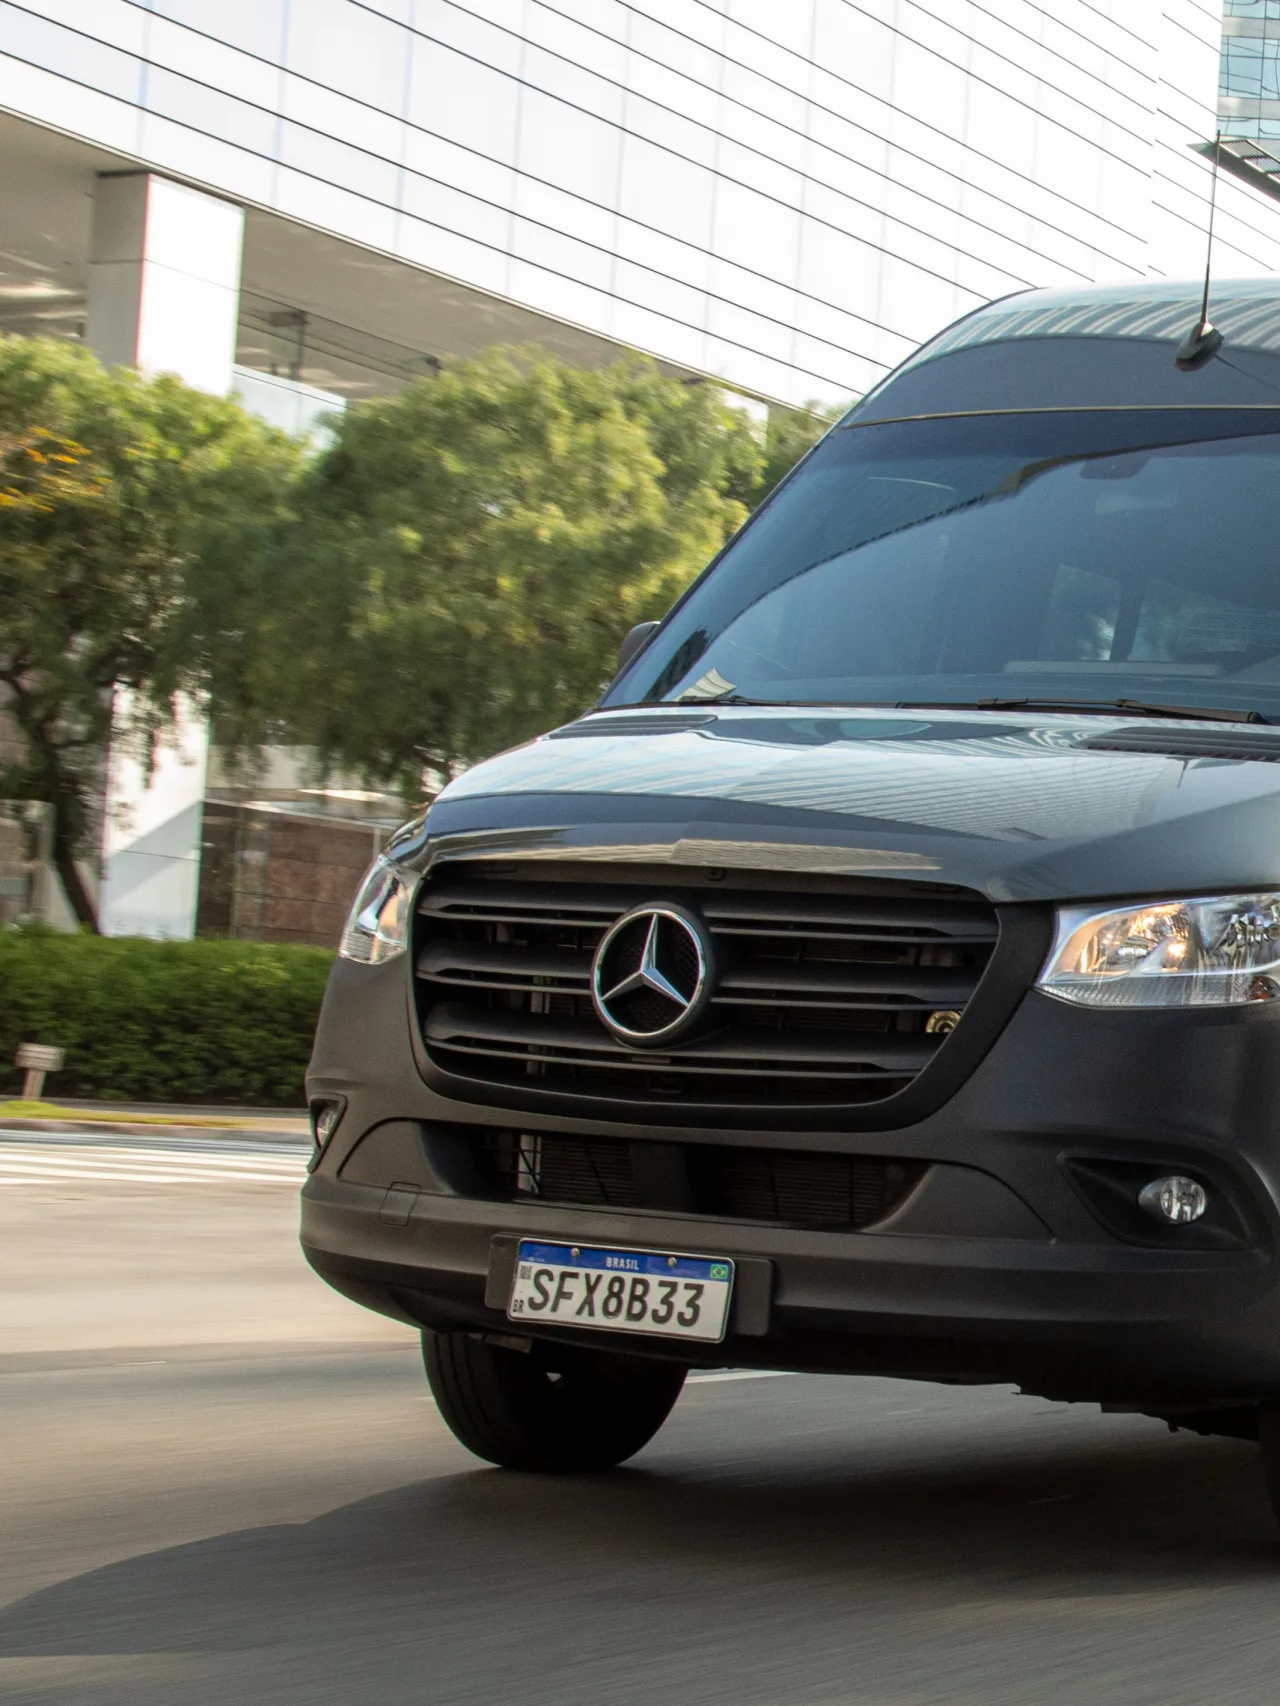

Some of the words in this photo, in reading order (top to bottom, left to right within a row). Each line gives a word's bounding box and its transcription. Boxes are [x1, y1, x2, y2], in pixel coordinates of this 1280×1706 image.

[606, 1256, 639, 1270] BRASIL
[528, 1269, 704, 1327] SFX8B33
[512, 1299, 524, 1313] BR
